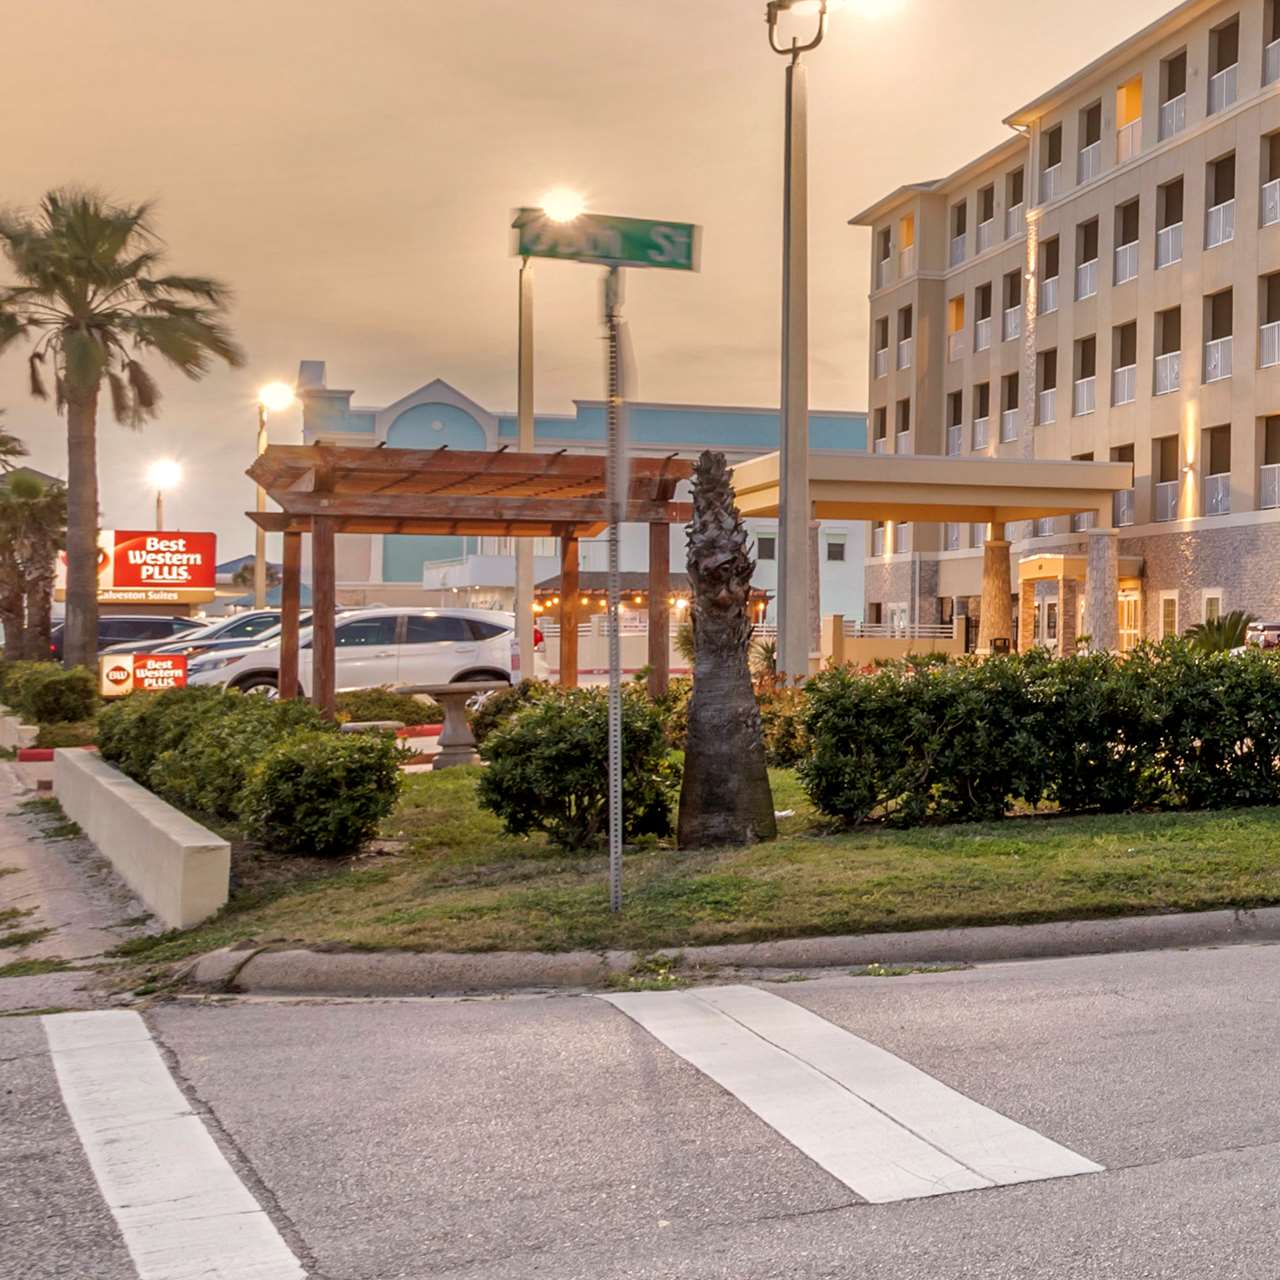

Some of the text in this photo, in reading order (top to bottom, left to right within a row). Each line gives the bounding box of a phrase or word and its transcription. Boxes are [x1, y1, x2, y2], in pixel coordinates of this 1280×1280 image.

[647, 224, 690, 264] St
[145, 536, 187, 552] Best
[127, 549, 202, 565] Western
[147, 590, 179, 601] Suites
[146, 659, 173, 669] Best
[108, 670, 128, 681] BW
[135, 668, 183, 678] Western
